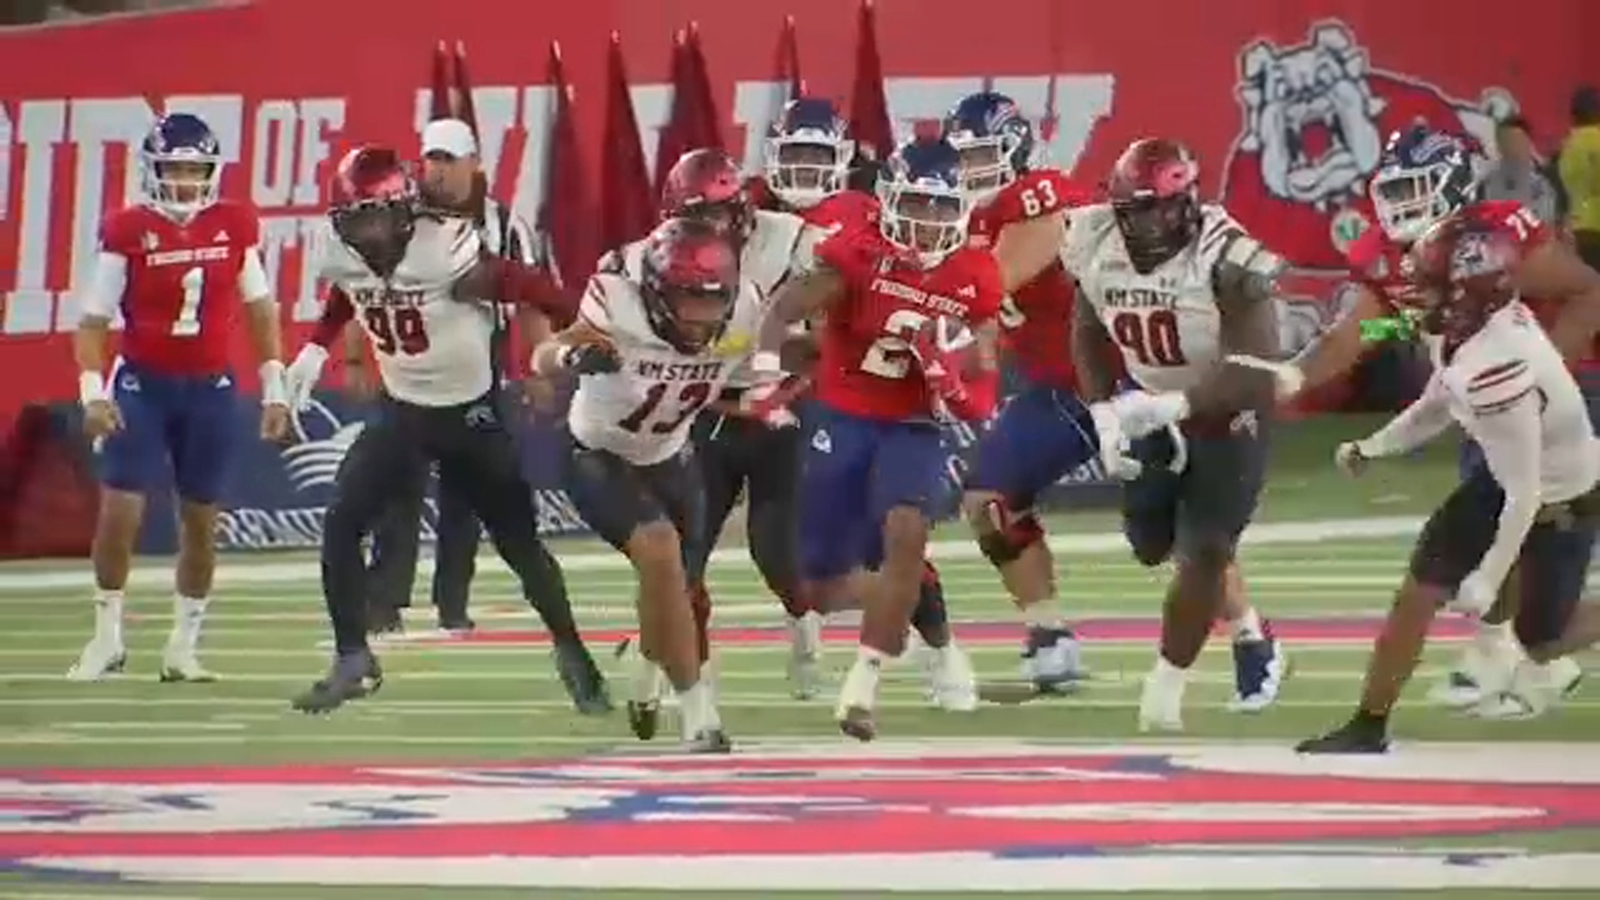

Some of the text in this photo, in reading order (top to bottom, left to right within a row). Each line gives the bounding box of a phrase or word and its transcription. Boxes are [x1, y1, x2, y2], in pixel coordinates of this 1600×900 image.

[252, 99, 346, 207] OF
[1020, 179, 1057, 216] 63
[171, 266, 204, 336] 1
[1113, 310, 1190, 367] 90
[617, 382, 711, 434] 13
